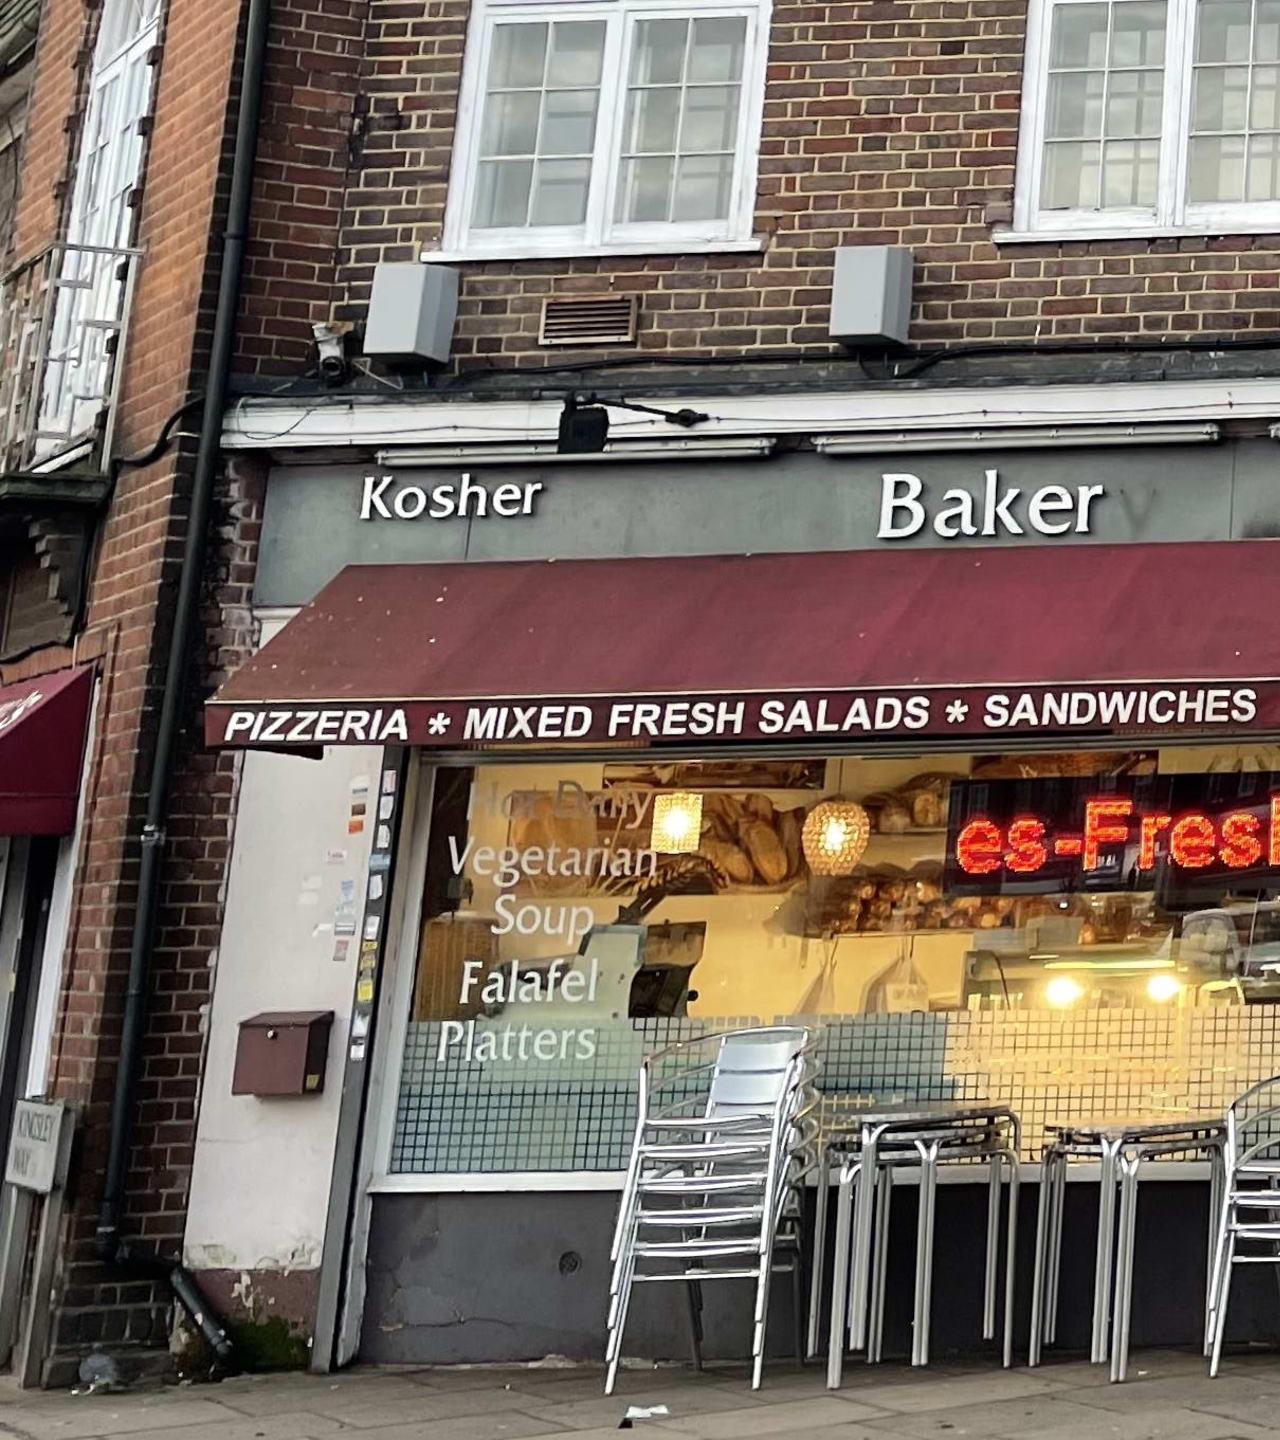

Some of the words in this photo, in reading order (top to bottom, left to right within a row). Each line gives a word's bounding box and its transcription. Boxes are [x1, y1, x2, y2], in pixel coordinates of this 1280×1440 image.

[359, 473, 543, 520] Kosher
[224, 709, 408, 742] PIZZERIA
[462, 705, 593, 741] MIXED
[607, 701, 745, 737] FRESH
[757, 695, 930, 734] SALADS
[982, 688, 1257, 728] SANDWICHES
[448, 835, 657, 886] Vegetarian
[491, 893, 595, 946] Soup
[459, 959, 598, 1005] Falafel
[437, 1019, 597, 1062] Platters
